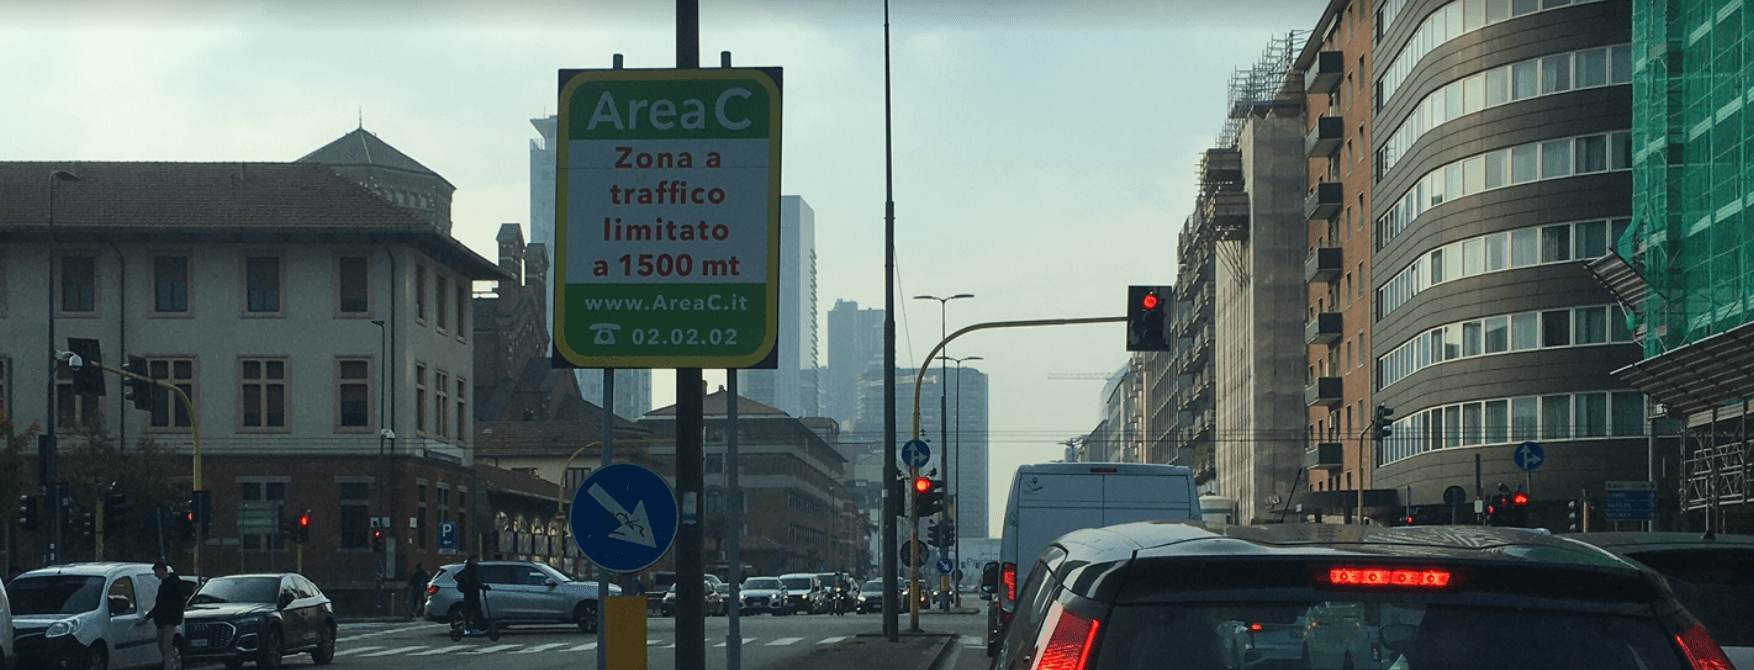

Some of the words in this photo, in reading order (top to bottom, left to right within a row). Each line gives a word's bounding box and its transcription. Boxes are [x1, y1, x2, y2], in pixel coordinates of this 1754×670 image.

[614, 146, 692, 168] Zona
[706, 152, 721, 168] a
[610, 180, 726, 205] traffico
[604, 217, 729, 241] limitato
[593, 260, 608, 276] a
[619, 253, 693, 277] 1500
[702, 256, 740, 276] mt
[585, 294, 747, 311] www.AreaC.it
[632, 328, 737, 345] 02.02.02
[442, 524, 453, 538] P
